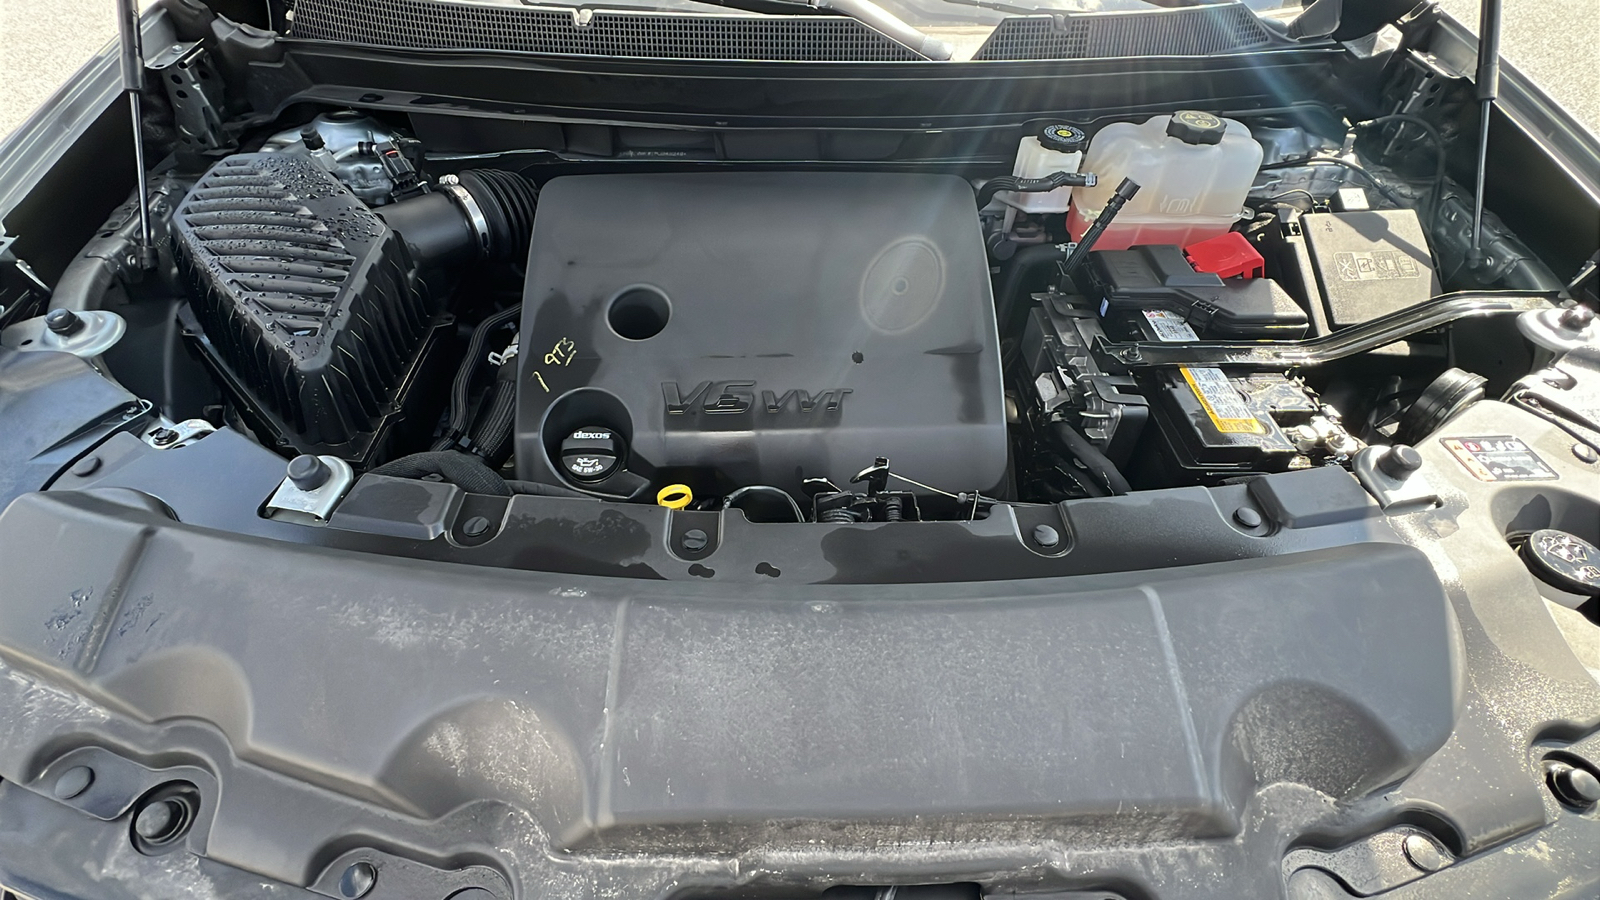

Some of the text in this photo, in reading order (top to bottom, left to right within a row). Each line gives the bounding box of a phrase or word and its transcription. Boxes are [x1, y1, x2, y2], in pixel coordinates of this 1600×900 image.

[661, 380, 854, 415] V6 VVT
[573, 430, 611, 439] dexos
